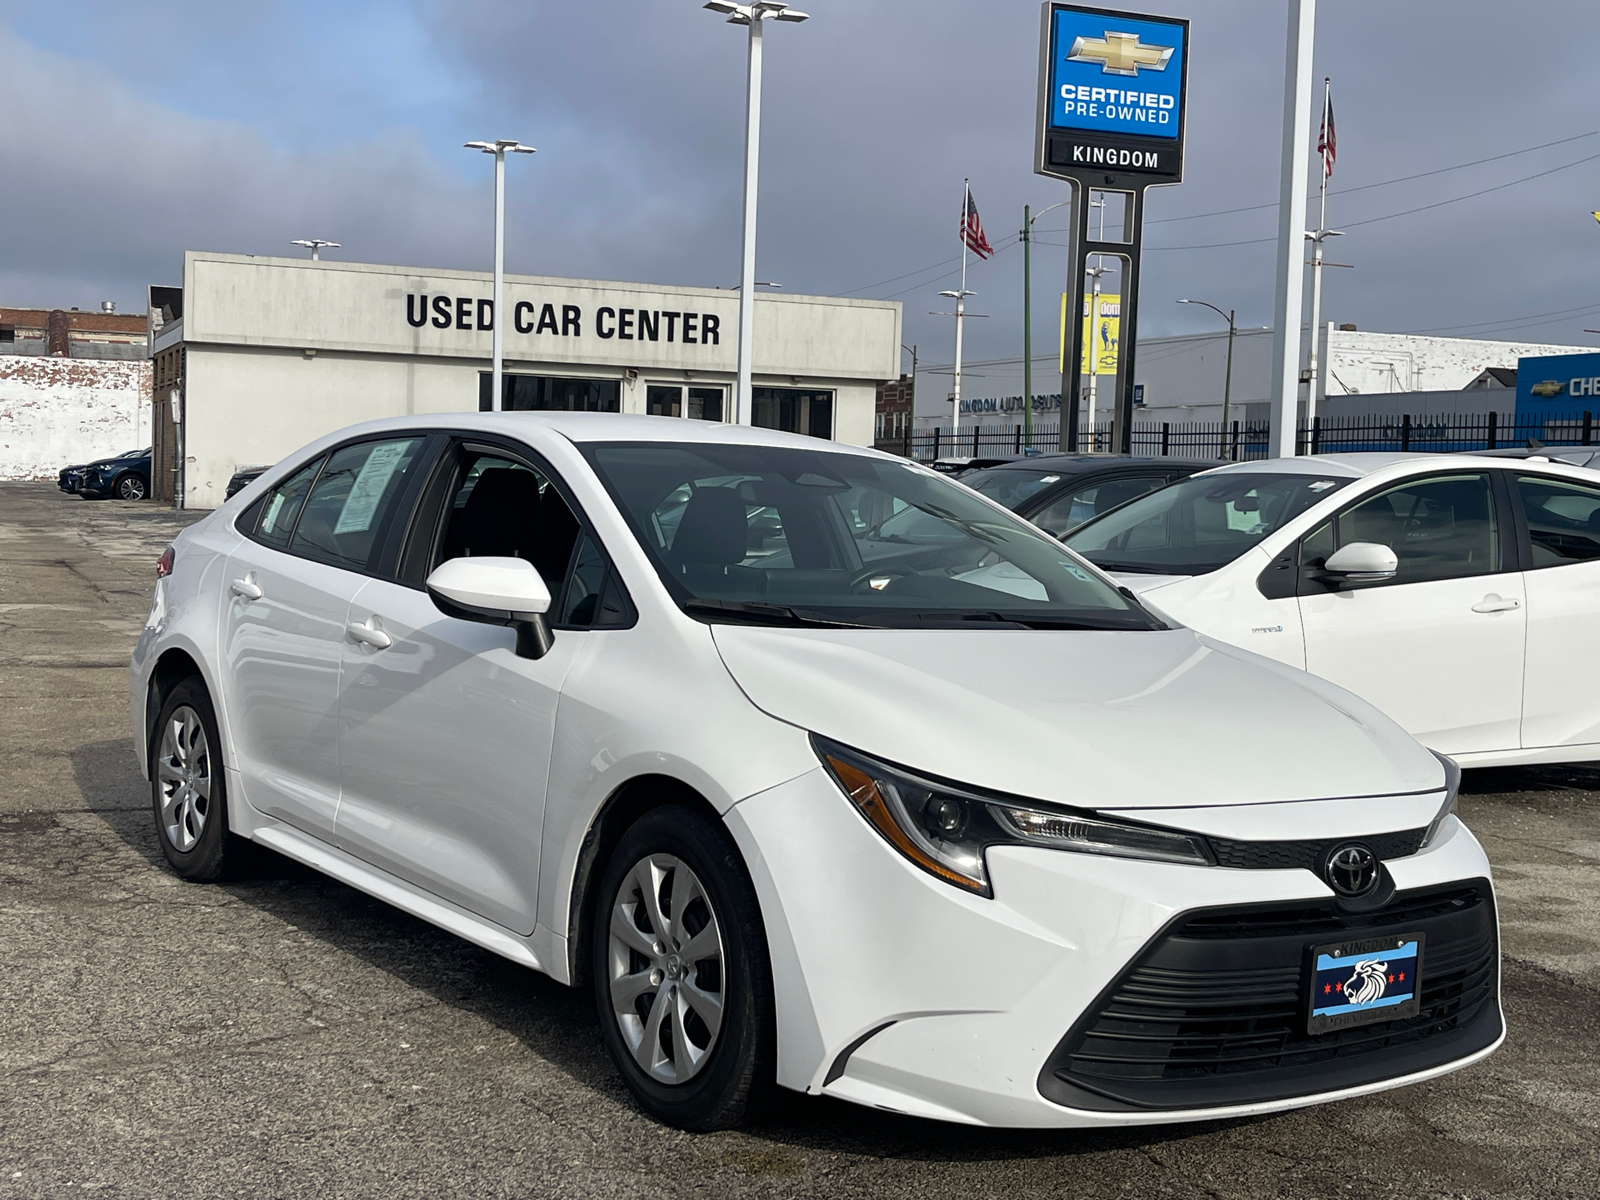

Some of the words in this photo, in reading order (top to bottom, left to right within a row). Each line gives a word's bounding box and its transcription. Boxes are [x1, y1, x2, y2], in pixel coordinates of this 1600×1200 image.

[1061, 84, 1175, 109] CERTIFIED
[1065, 101, 1169, 124] PRE-OWNED
[1073, 145, 1158, 169] KINGDOM
[406, 294, 494, 331] USED
[514, 301, 581, 337] CAR
[596, 307, 720, 345] CENTER
[1341, 936, 1398, 955] KINGDOM
